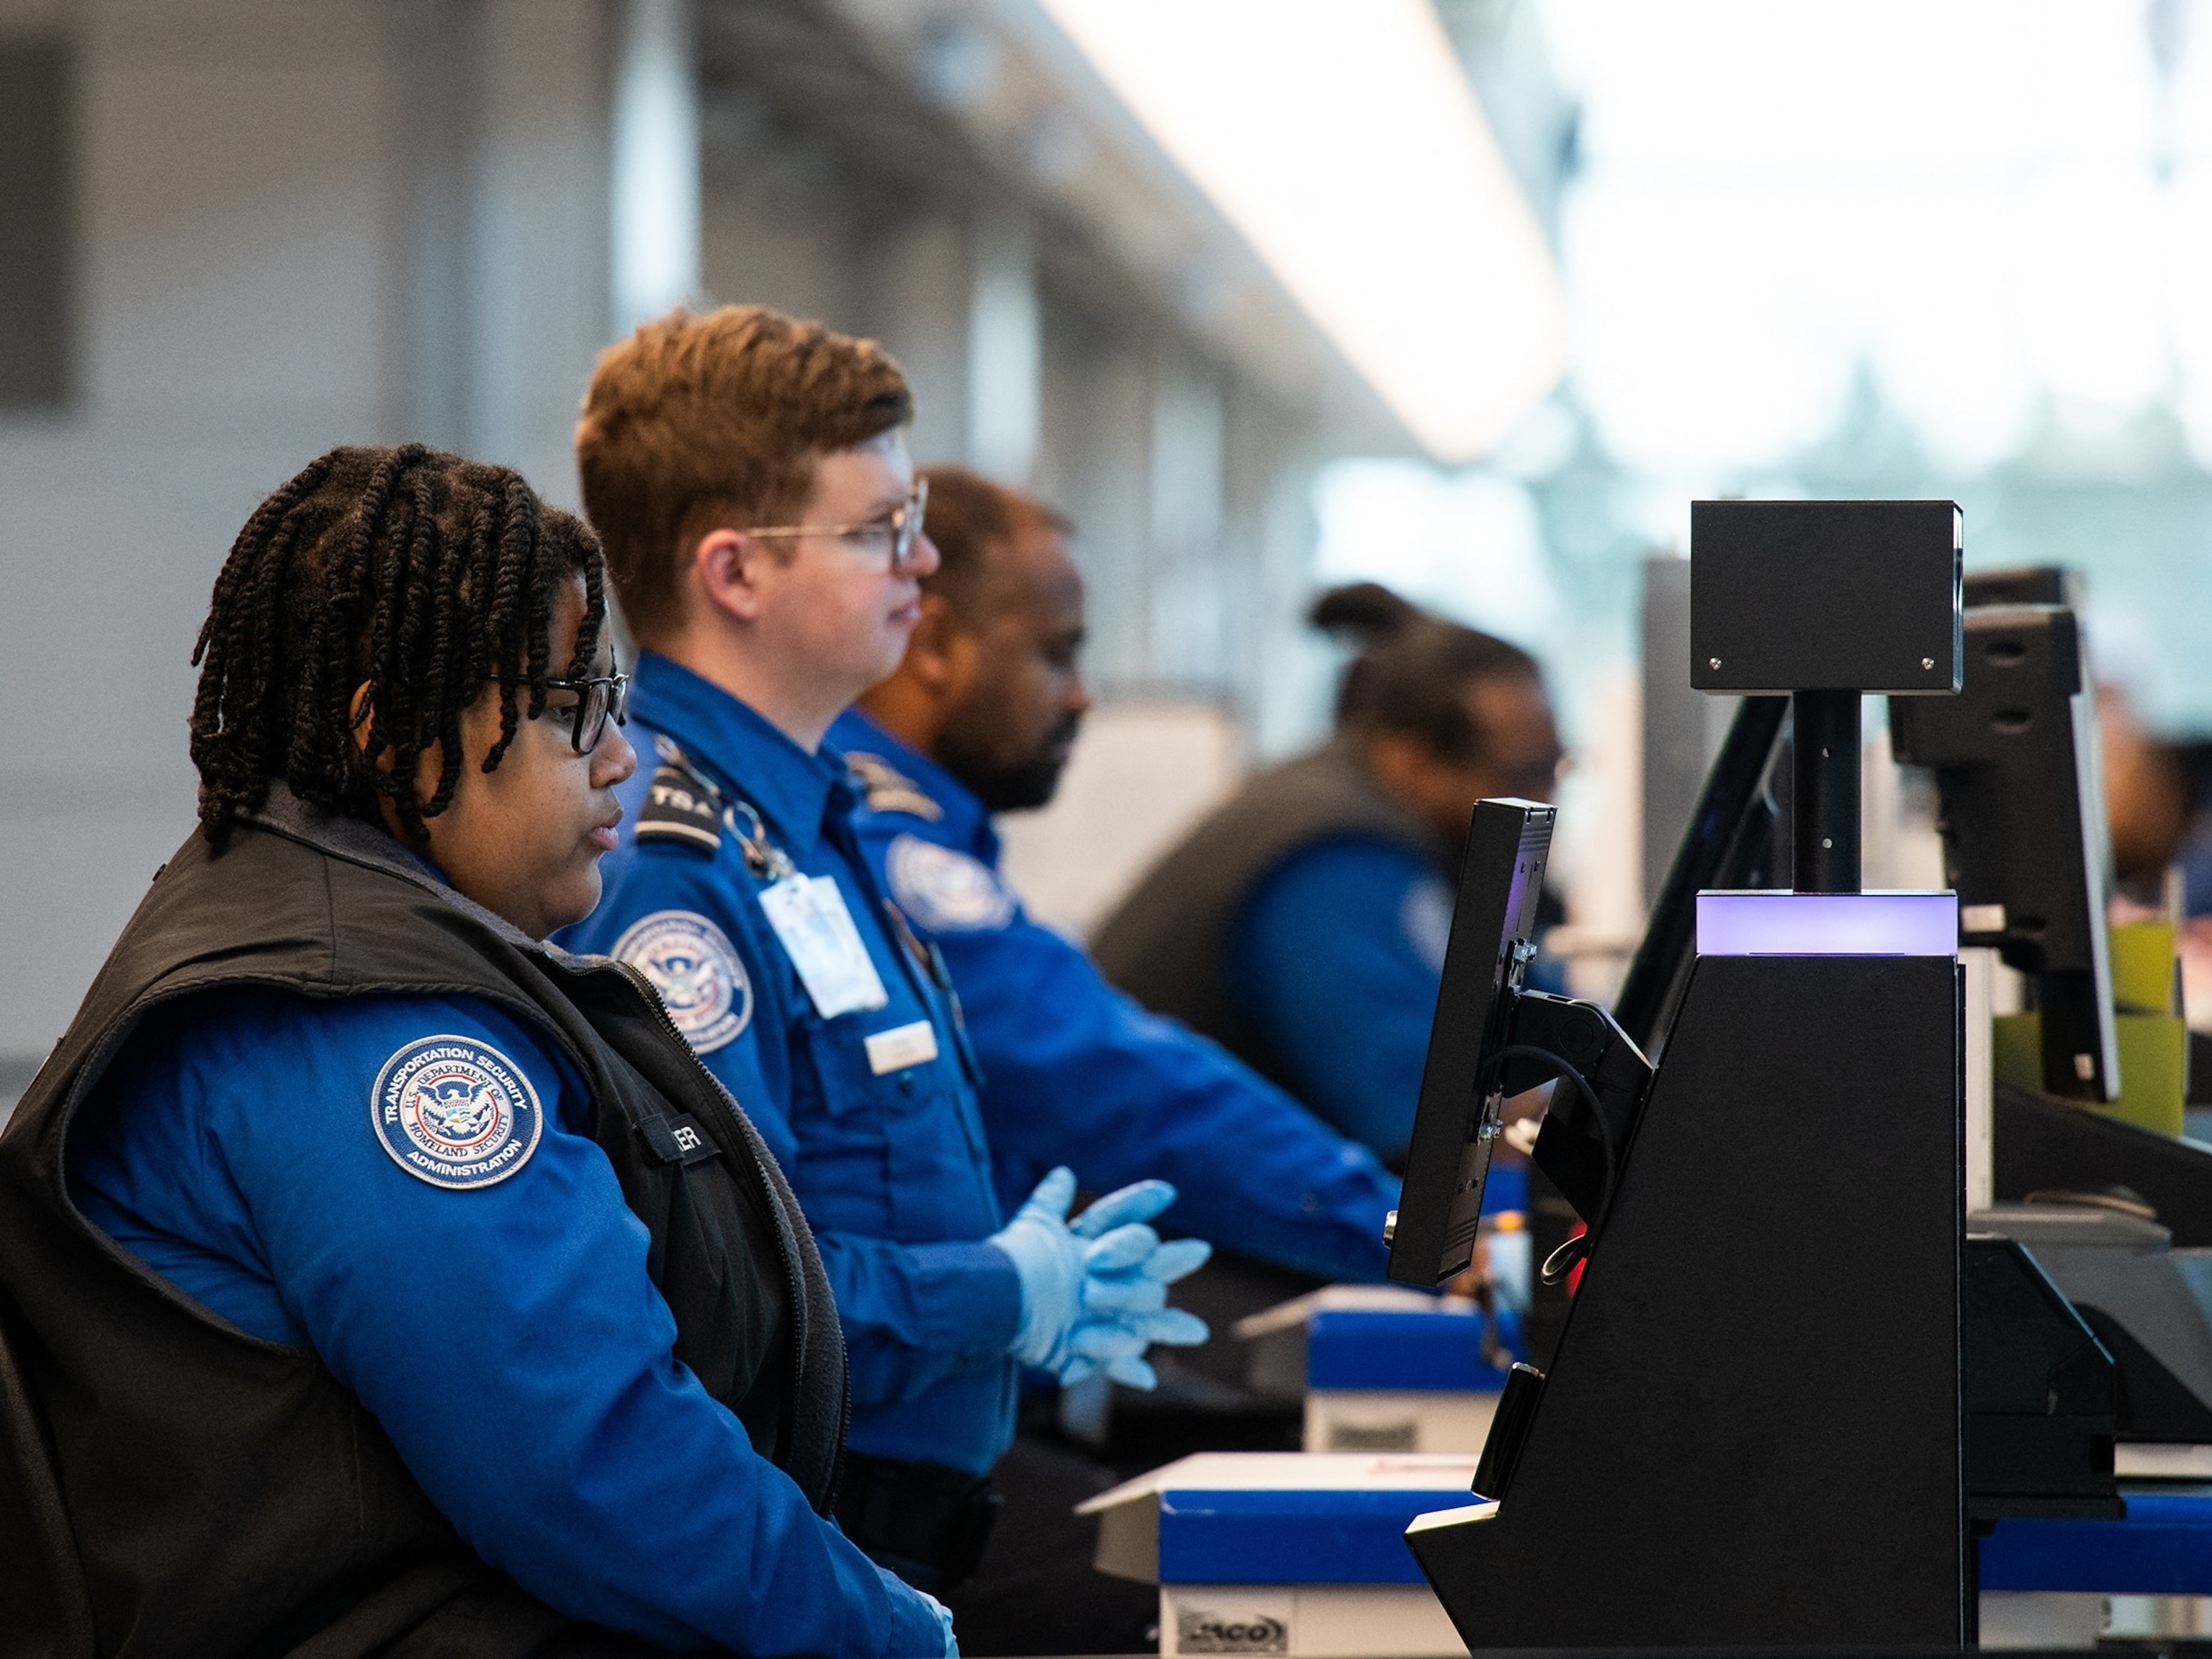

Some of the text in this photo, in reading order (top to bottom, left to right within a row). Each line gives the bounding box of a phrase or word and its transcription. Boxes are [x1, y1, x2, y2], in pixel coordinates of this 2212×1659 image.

[385, 1048, 528, 1124] TRANSPORTATION SECURITY
[418, 1065, 493, 1088] DEPARTMENT
[491, 1089, 503, 1101] OF
[409, 1112, 508, 1156] HOMELAND SECURITY
[672, 1126, 701, 1152] ER
[406, 1139, 523, 1176] ADMINISTRATION
